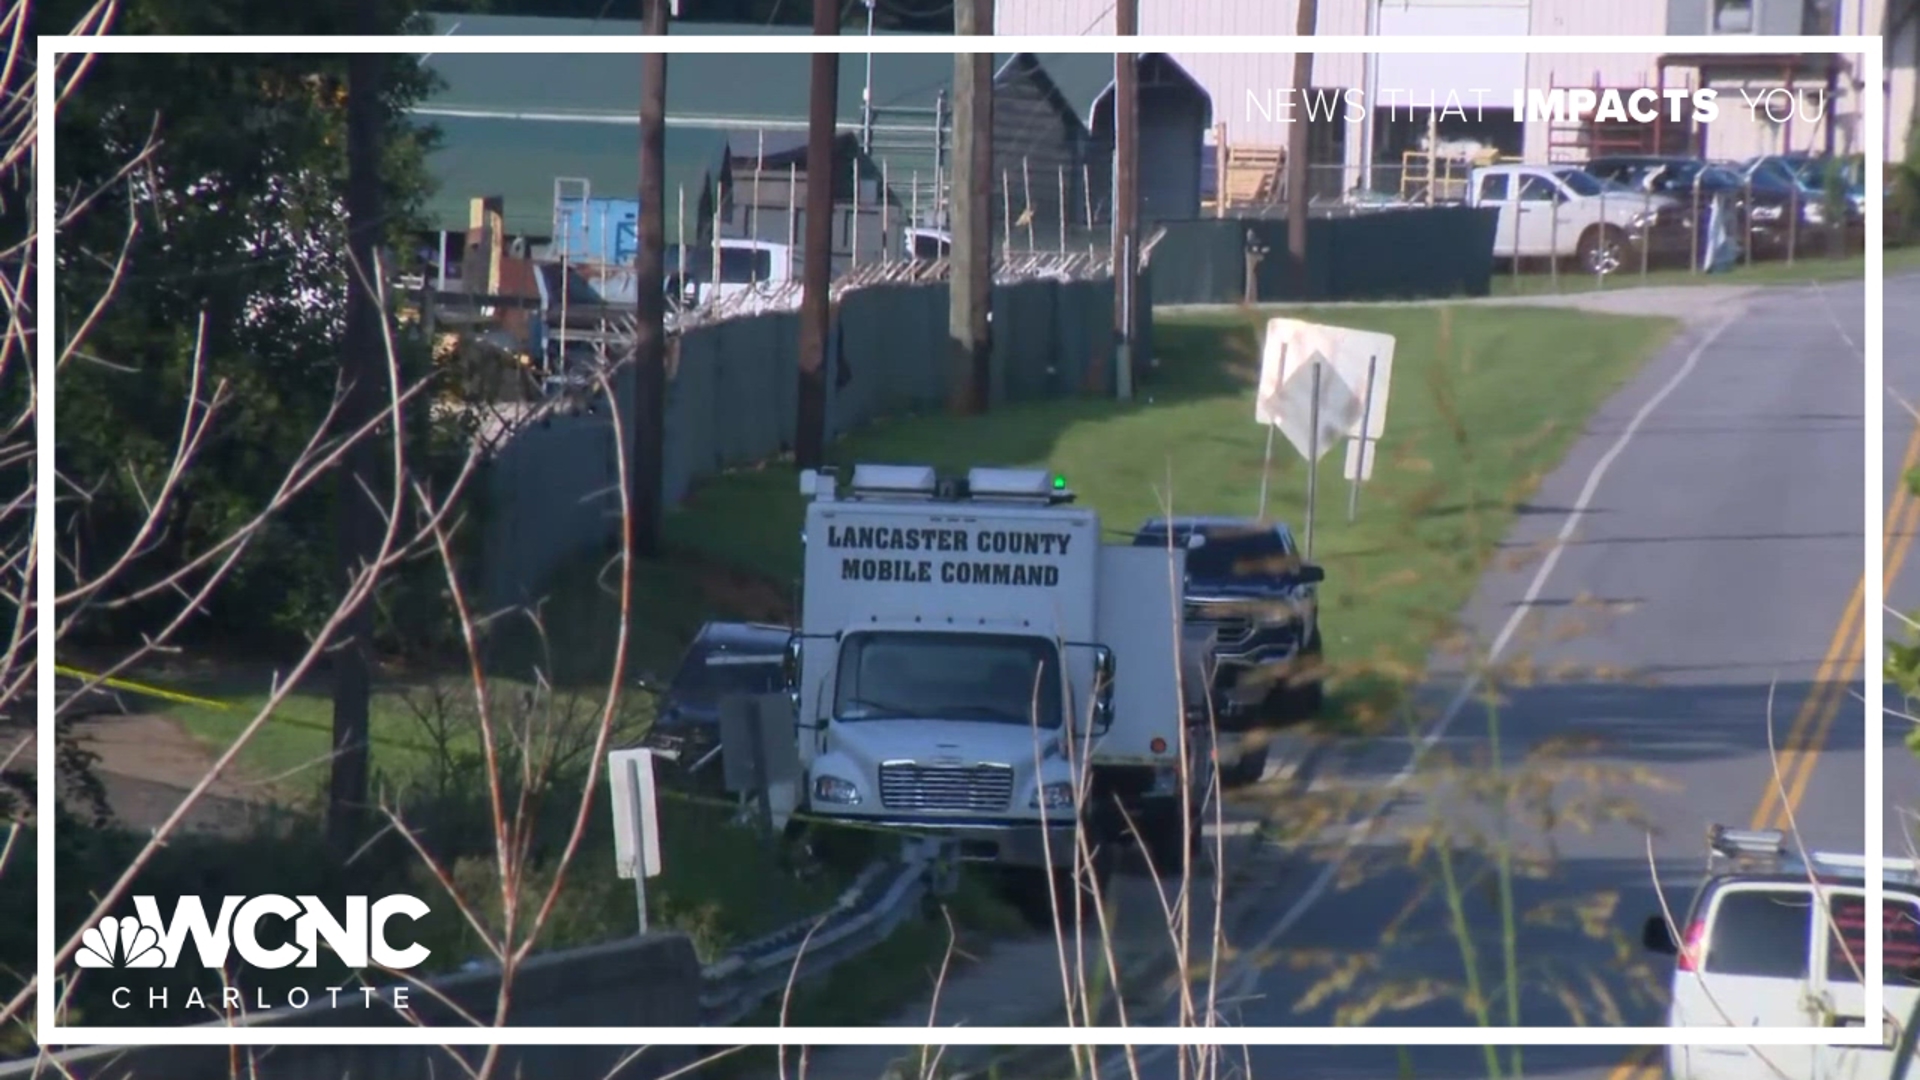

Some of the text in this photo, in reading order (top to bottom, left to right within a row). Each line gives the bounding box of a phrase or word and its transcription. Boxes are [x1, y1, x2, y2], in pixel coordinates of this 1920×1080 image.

[828, 526, 1071, 555] LANCASTER COUNTY
[841, 559, 1058, 587] MOBILE COMMAND
